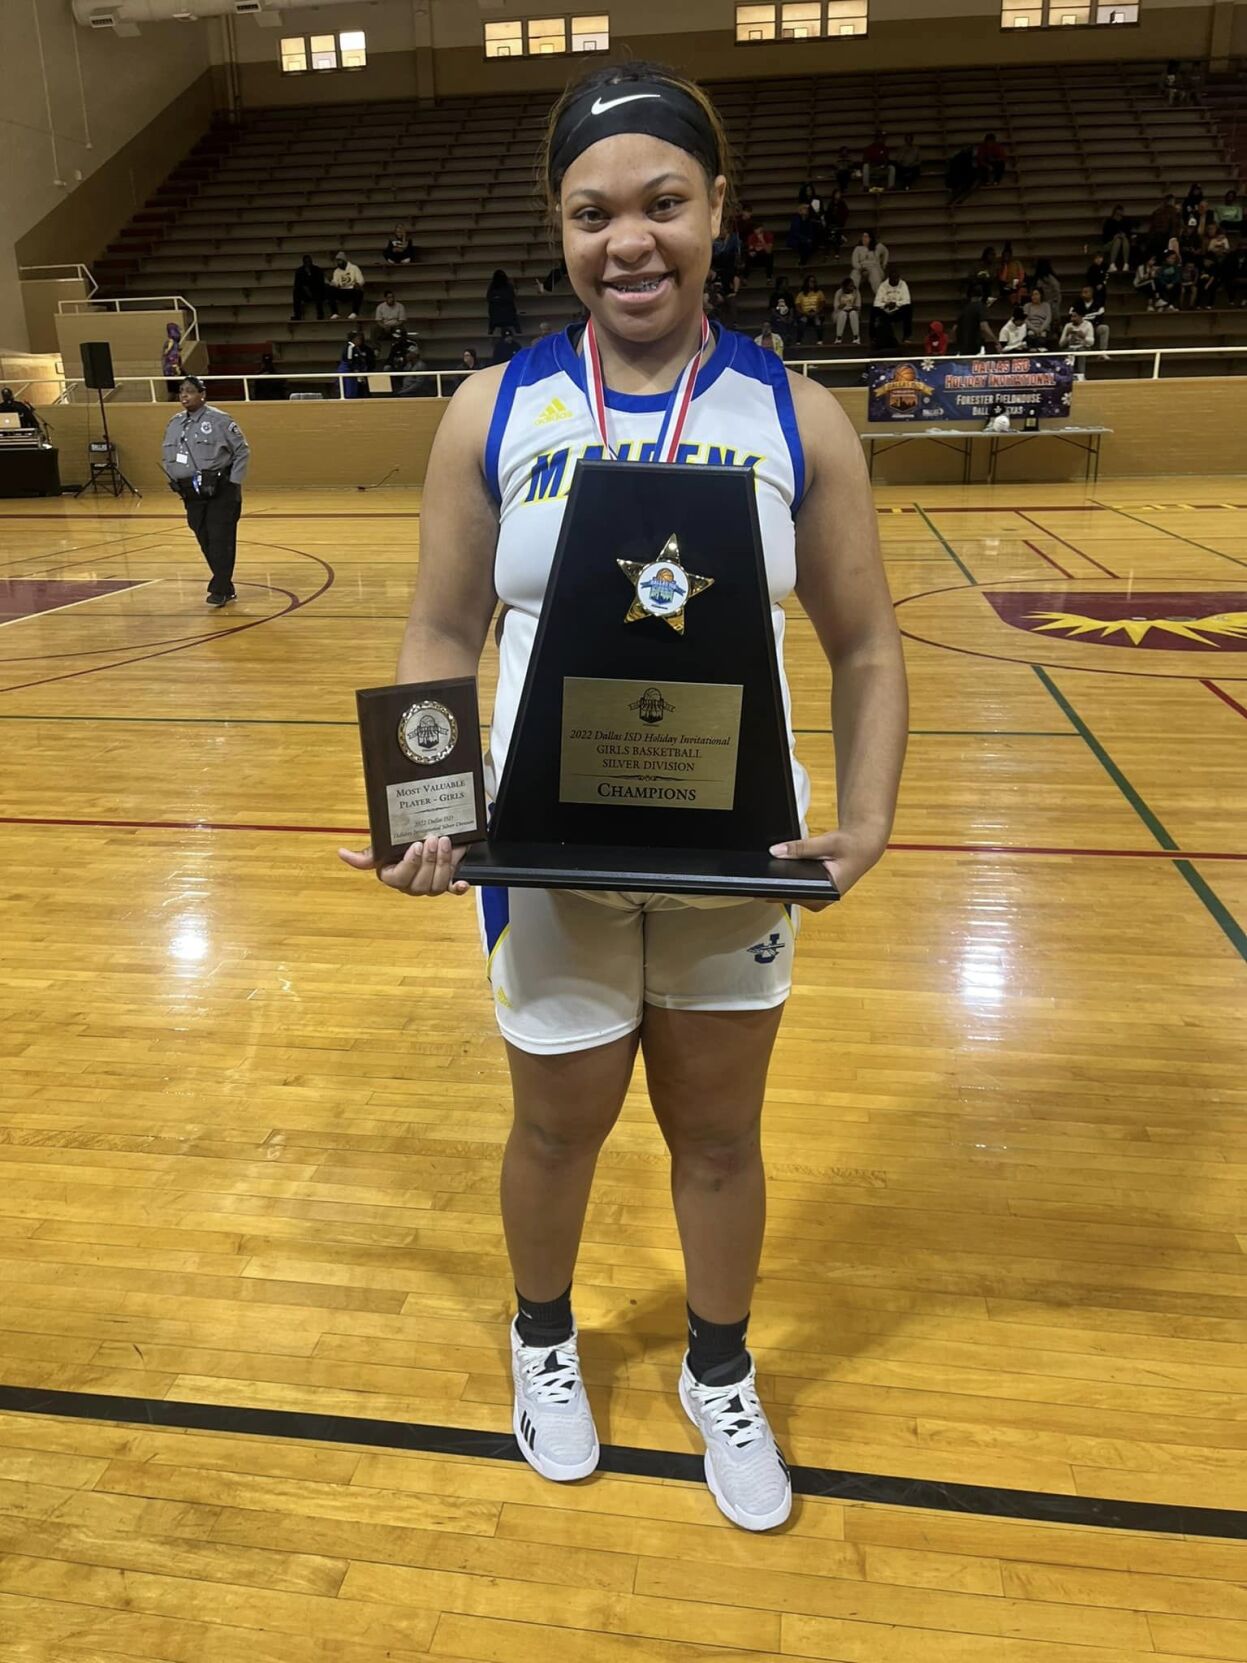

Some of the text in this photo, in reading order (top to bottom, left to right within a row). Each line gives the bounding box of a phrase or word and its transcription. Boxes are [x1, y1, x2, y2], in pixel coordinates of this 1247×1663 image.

[972, 360, 1010, 374] DALLAS
[945, 374, 987, 389] HOLIDAY
[956, 394, 994, 406] FORESTER
[569, 729, 731, 746] 2022 Dallas ISD Holiday Invitational
[596, 745, 702, 759] GIRLS BASKETBALL
[602, 759, 695, 772] SILVER DIVISION
[396, 780, 466, 798] MOST VALUABLE
[597, 782, 696, 801] CHAMPIONS
[399, 797, 431, 809] PLAYER
